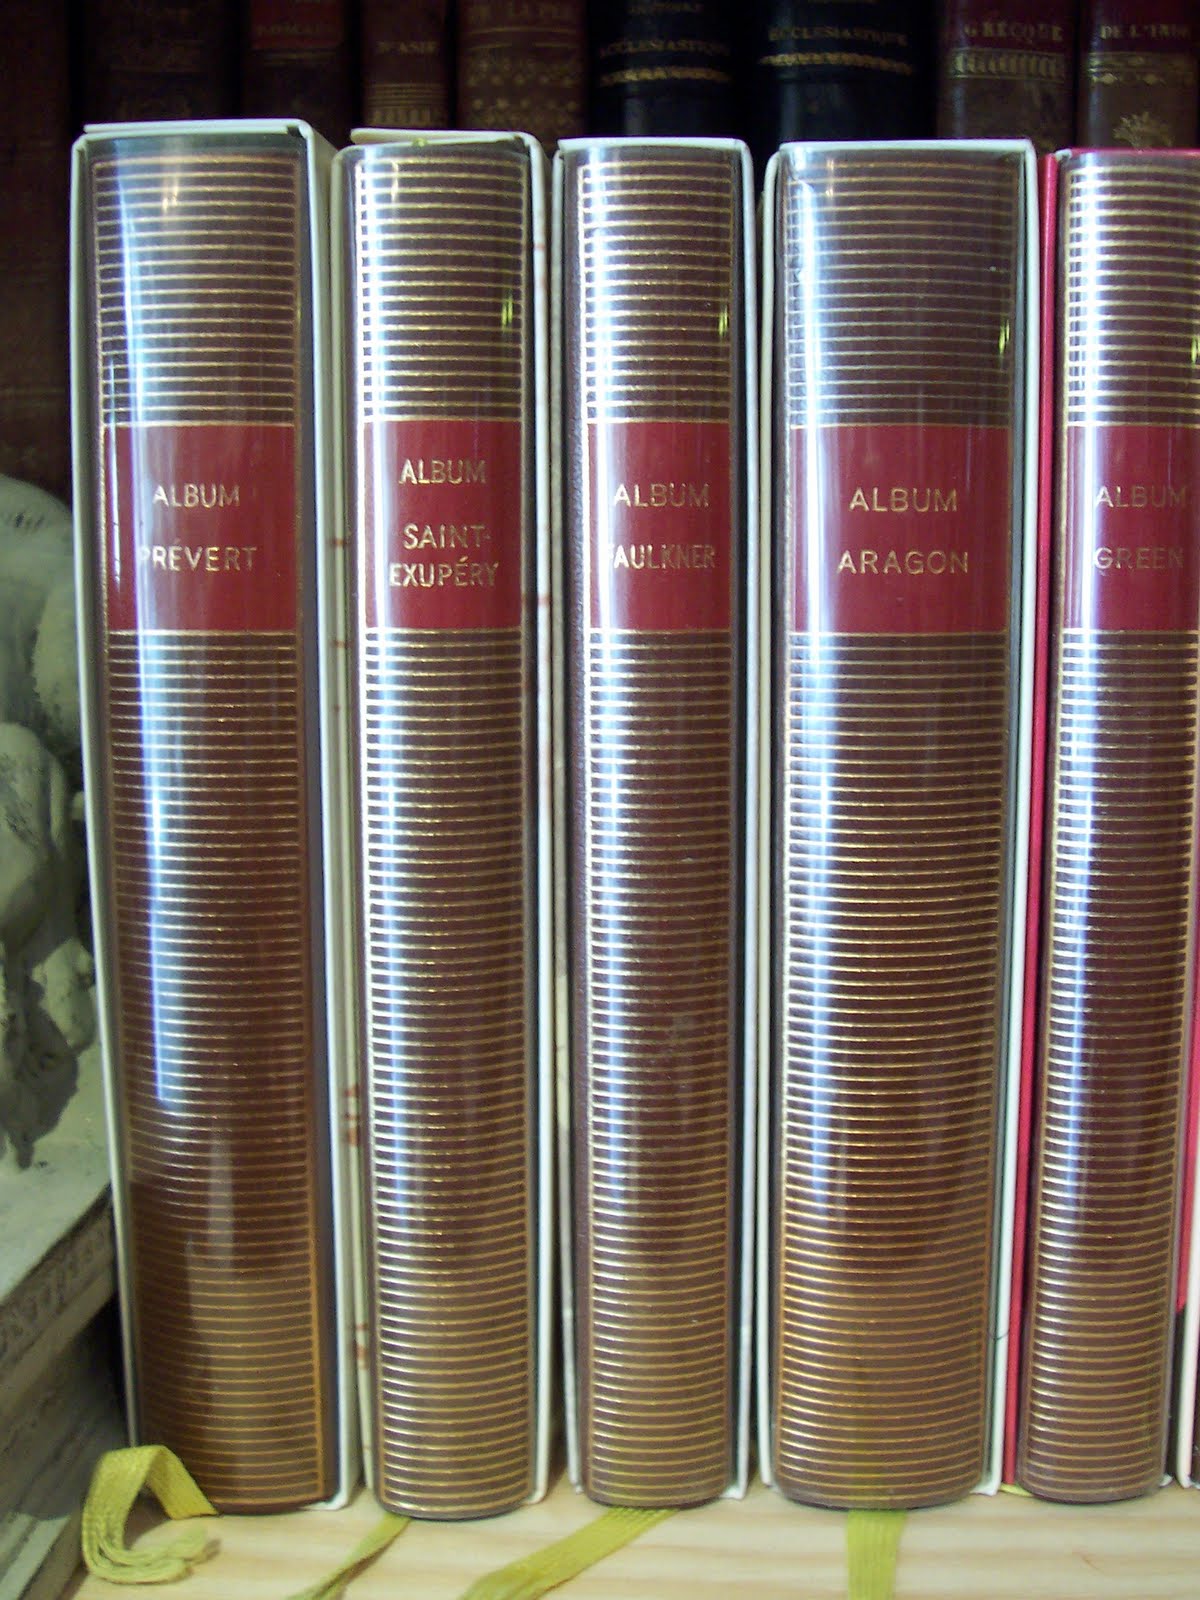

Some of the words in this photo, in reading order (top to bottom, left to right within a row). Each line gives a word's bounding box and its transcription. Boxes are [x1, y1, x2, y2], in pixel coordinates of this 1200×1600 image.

[399, 458, 487, 485] ALBUM
[152, 483, 241, 508] ALBUM
[614, 482, 709, 508] ALBUM
[849, 486, 958, 513] ALBUM
[1094, 485, 1187, 509] ALBUM
[403, 522, 491, 549] SAINT-
[135, 537, 257, 572] PRÉVERT
[836, 549, 969, 575] ARAGON
[1092, 546, 1184, 570] GREEN
[389, 555, 499, 587] EXUPÉRY
